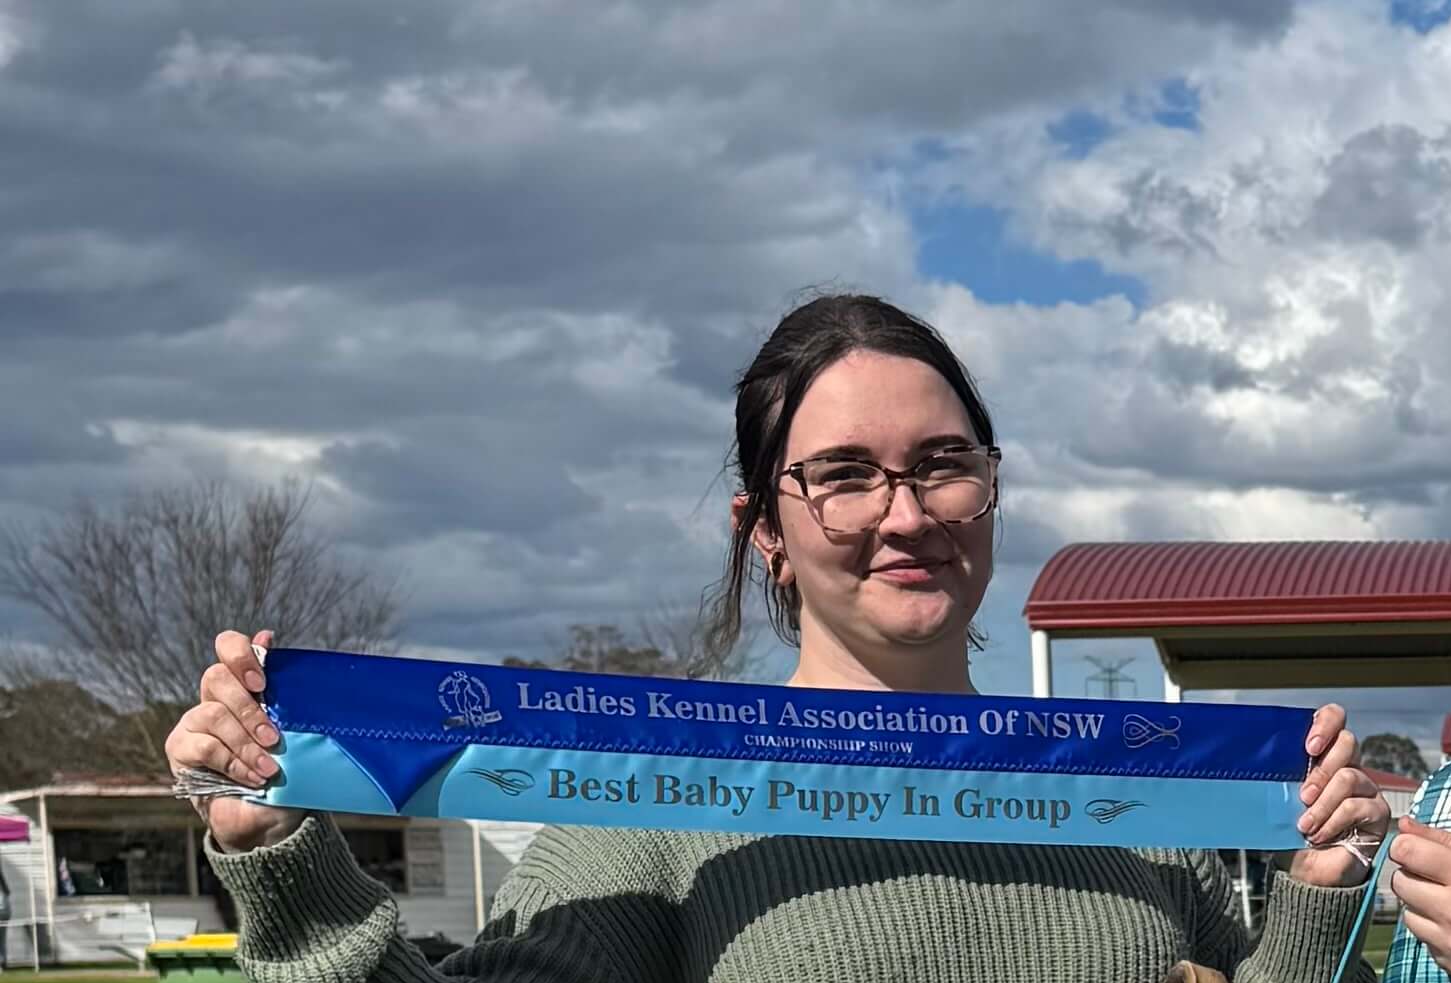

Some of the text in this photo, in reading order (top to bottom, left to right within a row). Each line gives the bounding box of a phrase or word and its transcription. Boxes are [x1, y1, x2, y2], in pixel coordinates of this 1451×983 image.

[516, 681, 637, 717] Ladies
[646, 691, 769, 725] Kennel
[777, 701, 969, 735] Association
[978, 708, 1019, 736] Of
[1025, 710, 1105, 740] NSW
[744, 734, 914, 754] CHAMPIONSHIP SHOW
[547, 768, 1072, 829] Best Baby Puppy In Group
